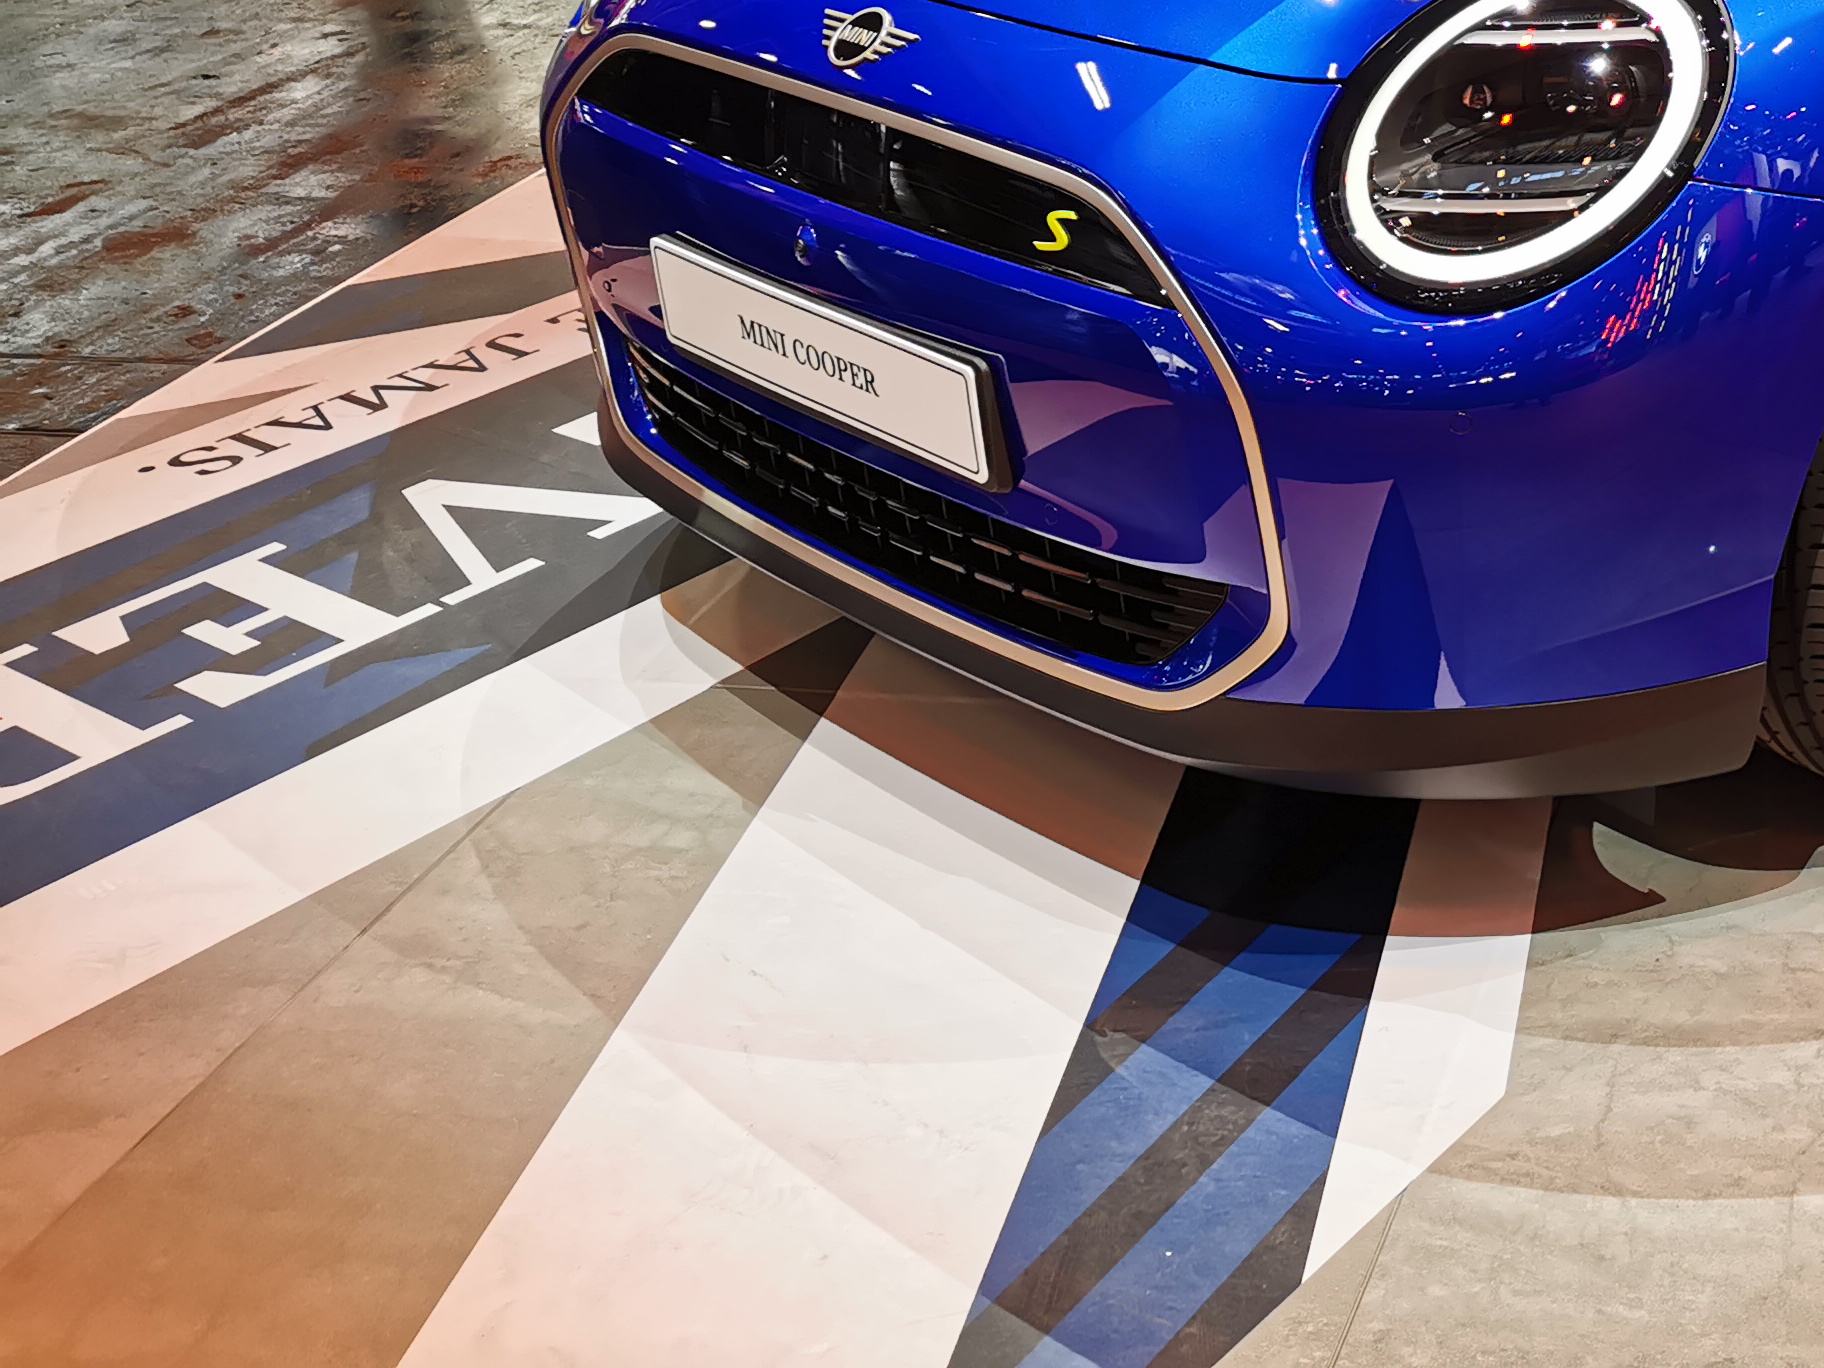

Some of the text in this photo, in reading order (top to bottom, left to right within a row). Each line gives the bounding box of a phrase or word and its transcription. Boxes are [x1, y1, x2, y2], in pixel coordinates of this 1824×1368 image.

[839, 24, 879, 48] MINI
[1031, 209, 1080, 252] S
[736, 313, 881, 398] MINI COOPER
[137, 331, 541, 477] JAMAIS.
